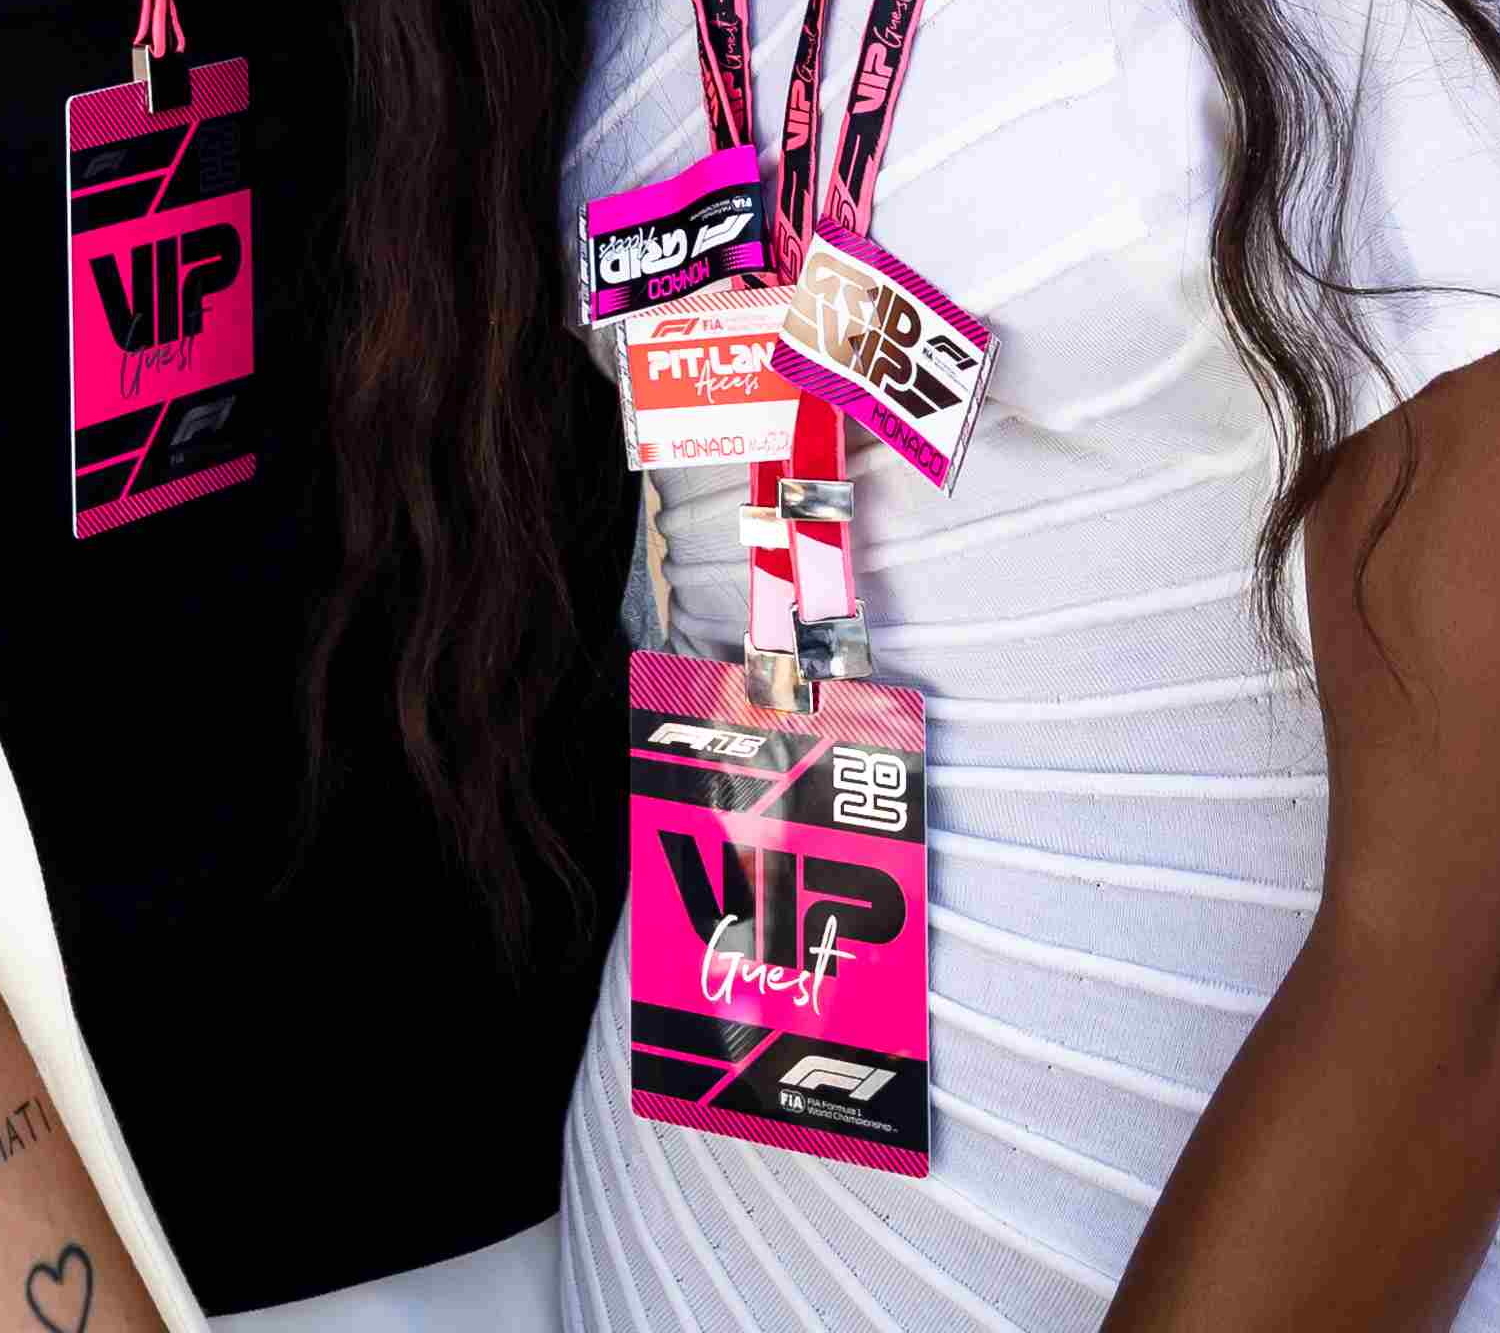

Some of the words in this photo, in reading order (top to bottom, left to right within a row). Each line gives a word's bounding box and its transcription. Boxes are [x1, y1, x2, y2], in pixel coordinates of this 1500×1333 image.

[851, 41, 895, 115] VIP
[784, 78, 812, 152] VIP
[599, 229, 688, 284] GRID
[647, 256, 711, 301] MONACO
[88, 222, 243, 354] VIP
[651, 316, 701, 338] F1
[701, 319, 722, 331] FIA
[120, 303, 213, 401] Guest
[646, 346, 705, 381] PIT
[925, 334, 979, 372] F1
[693, 359, 760, 404] Access
[671, 435, 745, 459] MONACO
[871, 403, 946, 479] MONACO
[657, 828, 907, 978] VIP
[700, 913, 857, 1016] Guest
[777, 1054, 898, 1102] F1
[780, 1090, 804, 1112] FIA
[807, 1097, 821, 1108] FIA
[822, 1100, 857, 1116] Formula
[807, 1106, 832, 1120] World
